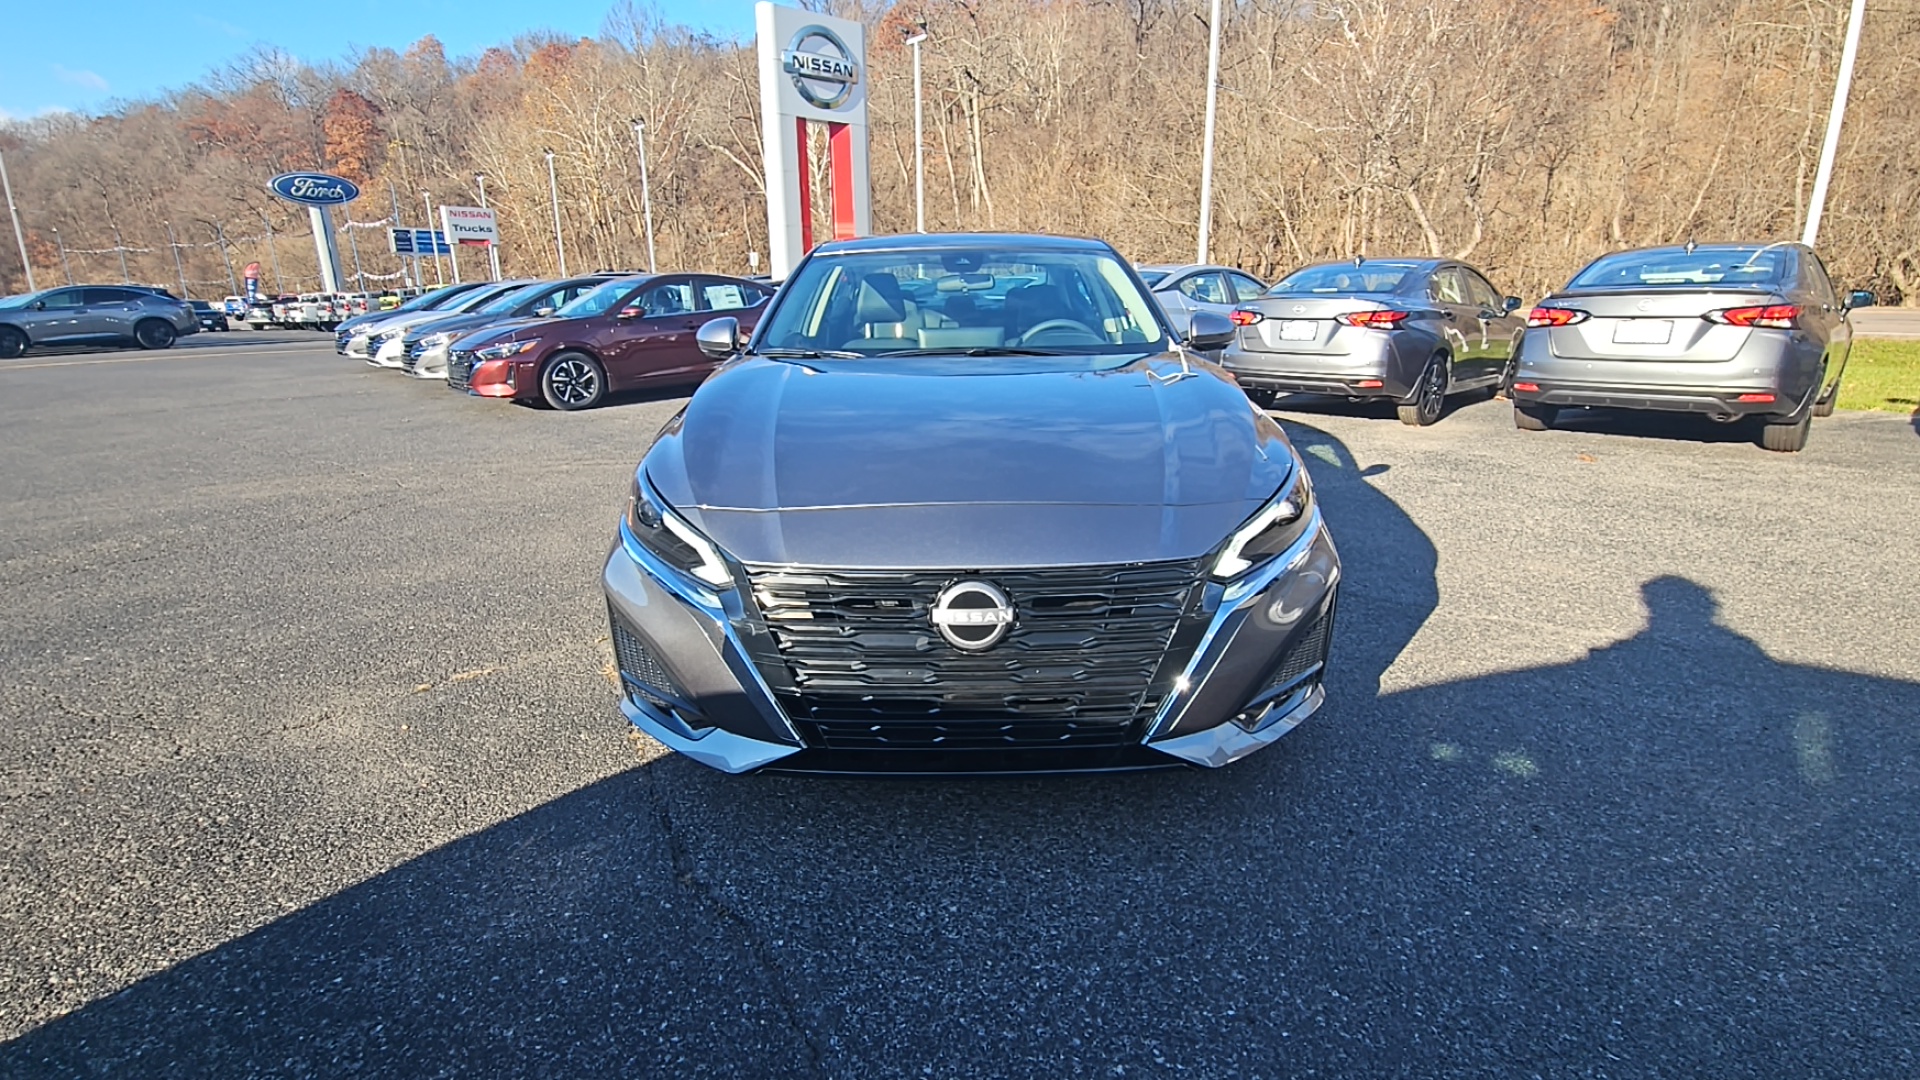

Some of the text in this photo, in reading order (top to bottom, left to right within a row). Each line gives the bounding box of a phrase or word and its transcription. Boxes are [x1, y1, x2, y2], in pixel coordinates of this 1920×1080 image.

[792, 55, 853, 78] NISSAN
[290, 177, 342, 198] Ford
[449, 210, 491, 219] NISSAN
[452, 223, 493, 233] Trucks
[934, 610, 1012, 623] ISSAN
